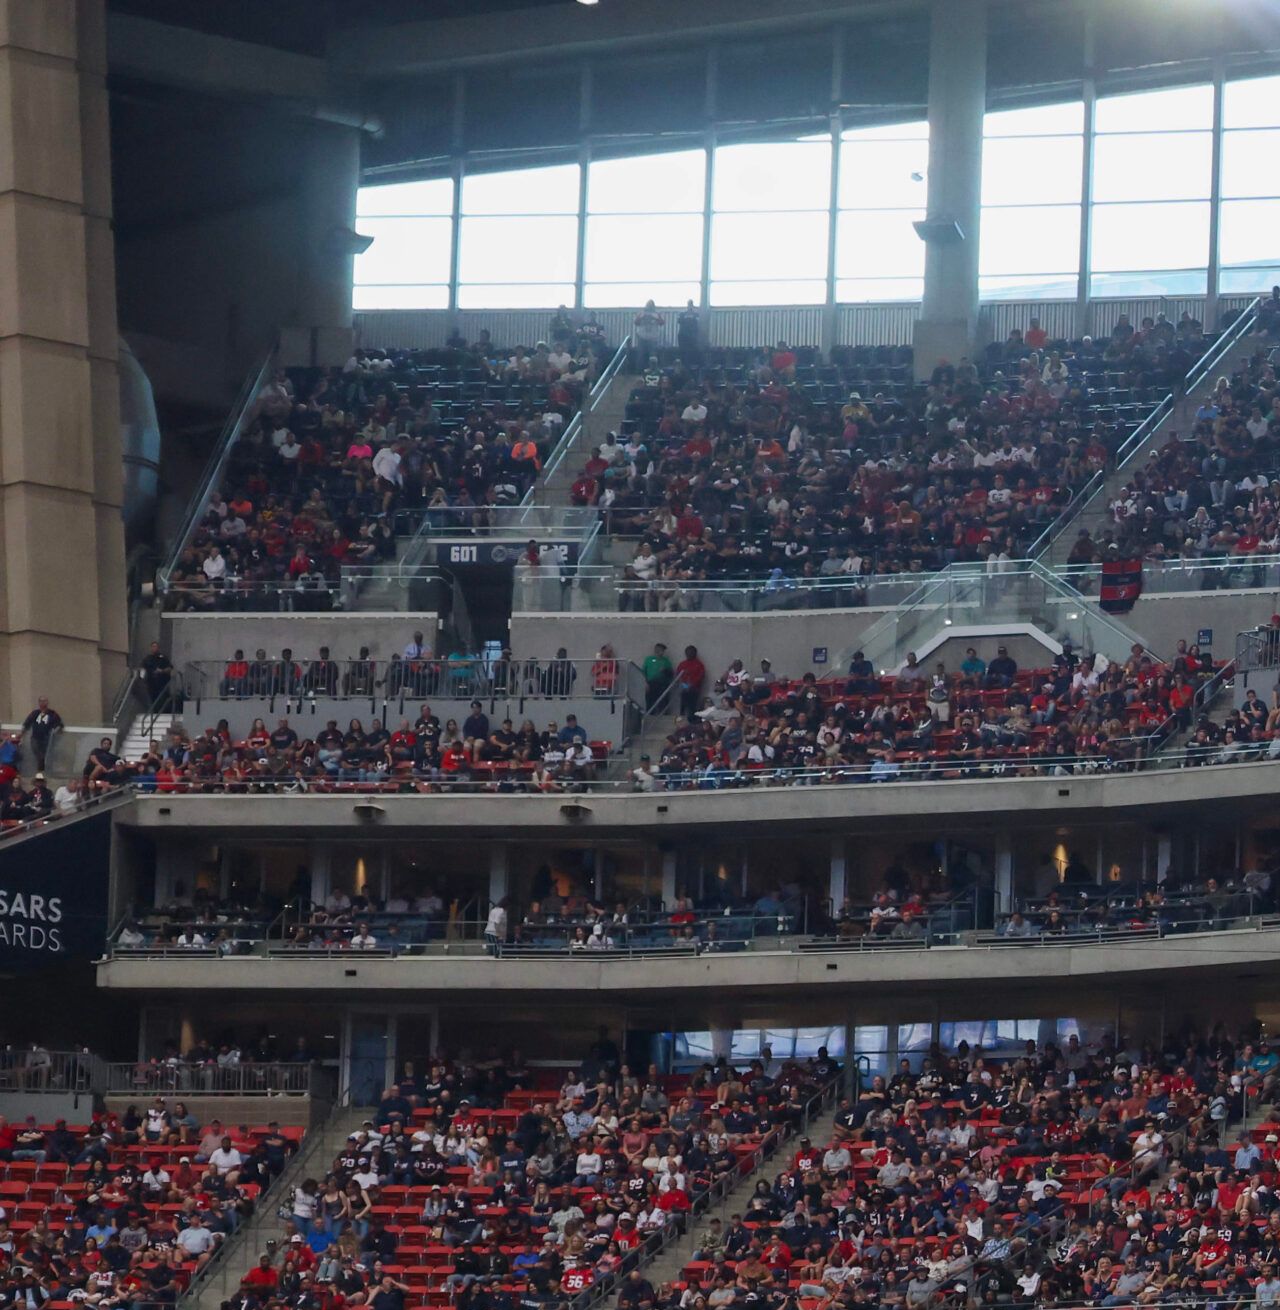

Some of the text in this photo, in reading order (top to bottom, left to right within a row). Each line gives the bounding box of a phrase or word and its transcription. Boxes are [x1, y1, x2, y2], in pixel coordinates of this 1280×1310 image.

[450, 546, 477, 562] 601
[36, 714, 49, 725] 44
[970, 1094, 978, 1102] 7
[845, 1115, 854, 1125] 7
[870, 1214, 881, 1225] 51
[1218, 1230, 1232, 1242] 59
[567, 1275, 583, 1288] 56
[240, 1300, 248, 1310] 7
[298, 1295, 305, 1304] 7
